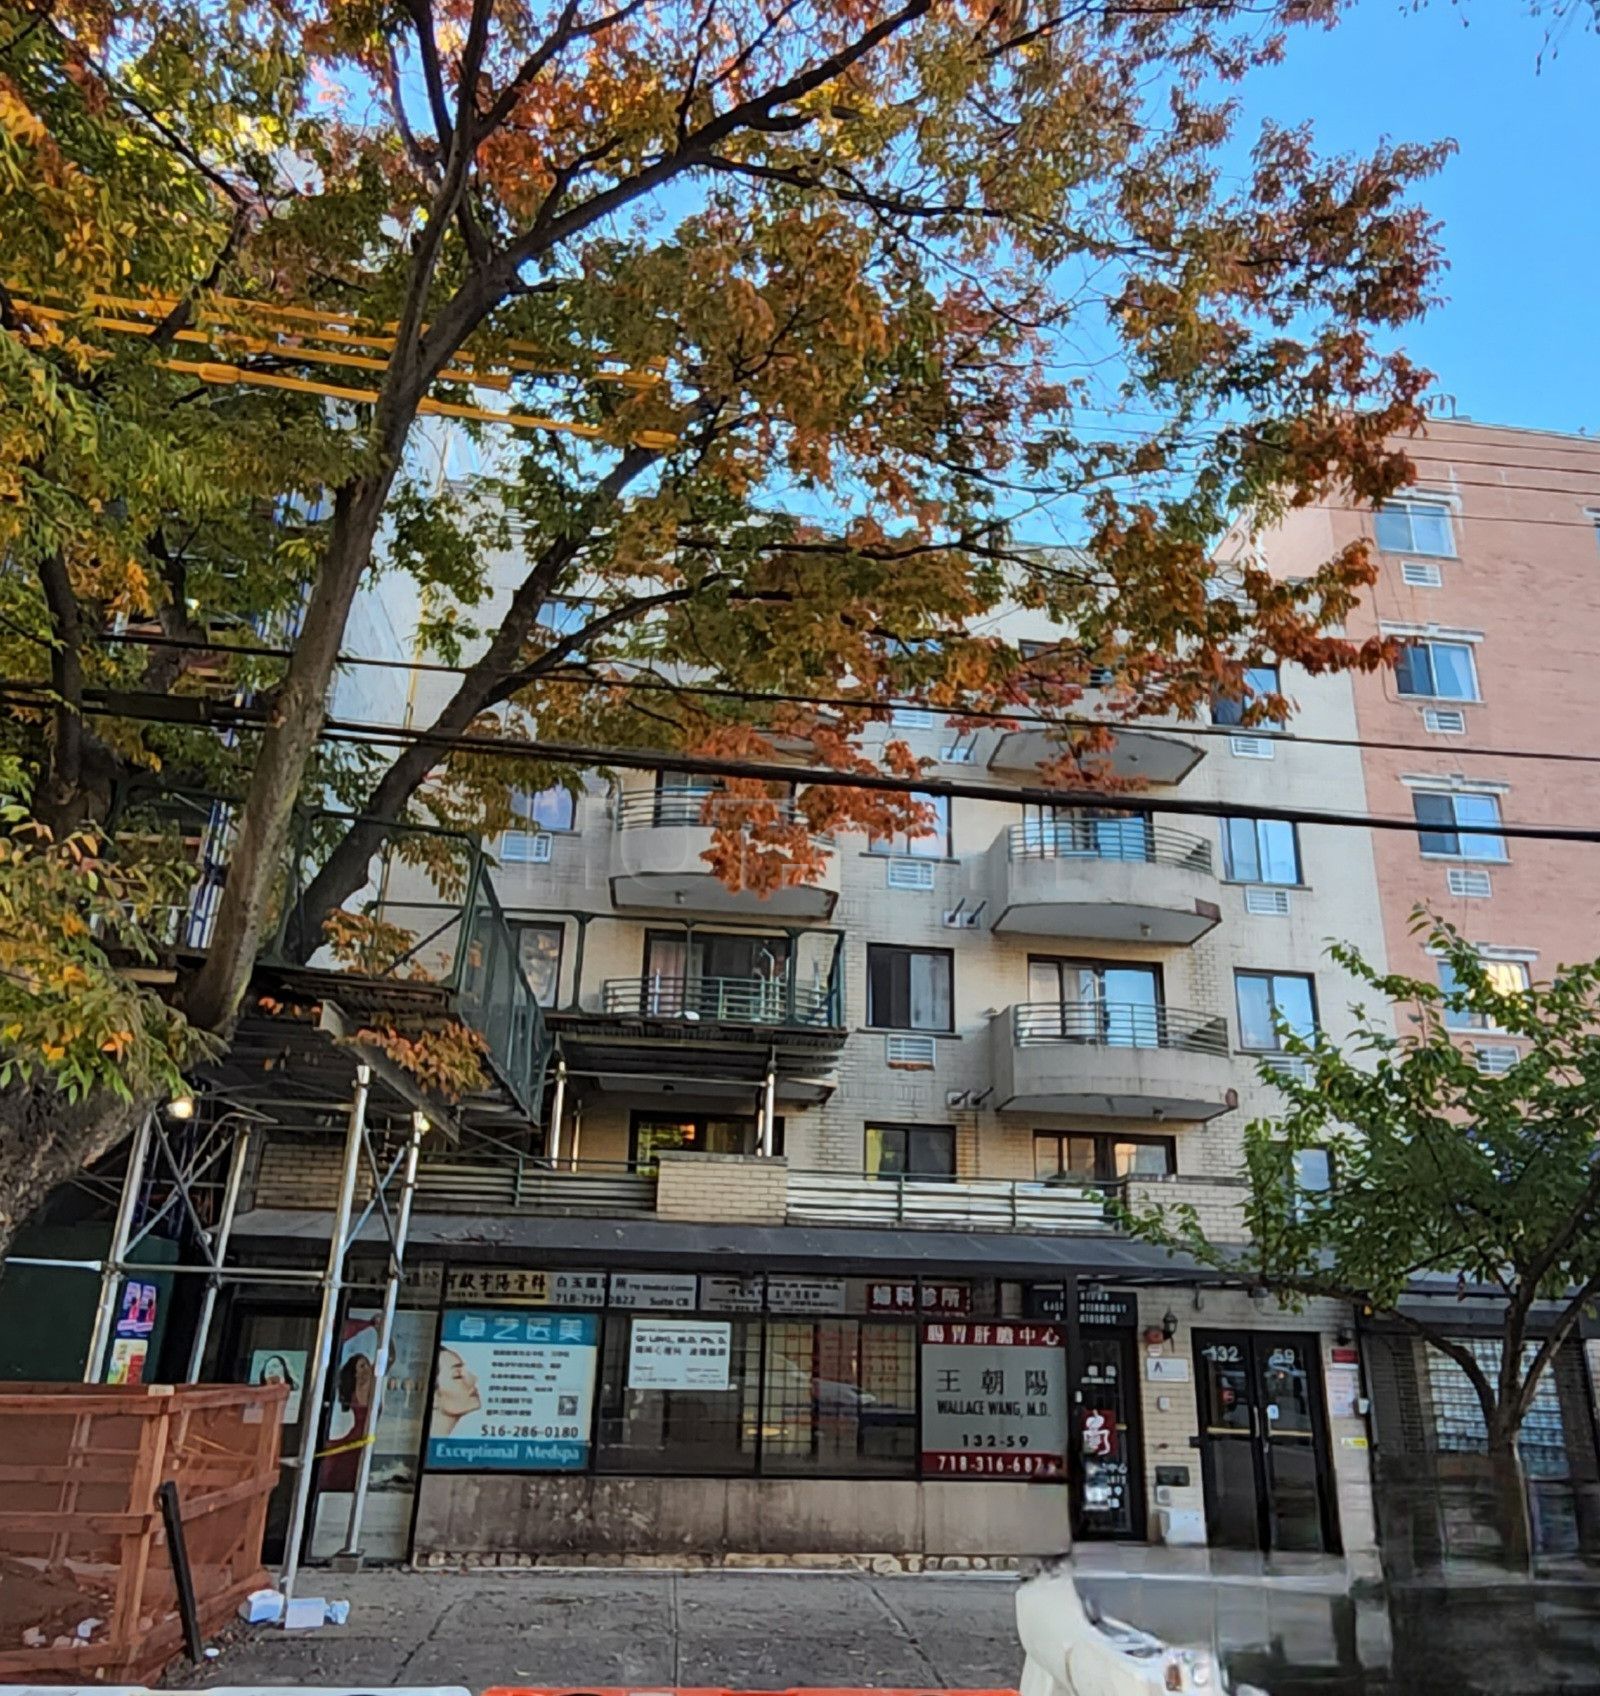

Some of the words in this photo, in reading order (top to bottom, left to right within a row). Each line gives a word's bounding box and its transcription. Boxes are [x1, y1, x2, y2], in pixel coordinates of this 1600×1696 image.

[936, 1368, 1048, 1396] 王朝陽
[937, 1400, 984, 1416] WALLACE
[988, 1401, 1023, 1419] WANG,
[1026, 1402, 1051, 1417] M.D.
[481, 1424, 579, 1438] 516-286-0180
[962, 1434, 1029, 1447] 132-59
[436, 1444, 518, 1462] Exceptional
[525, 1445, 580, 1464] Medspa
